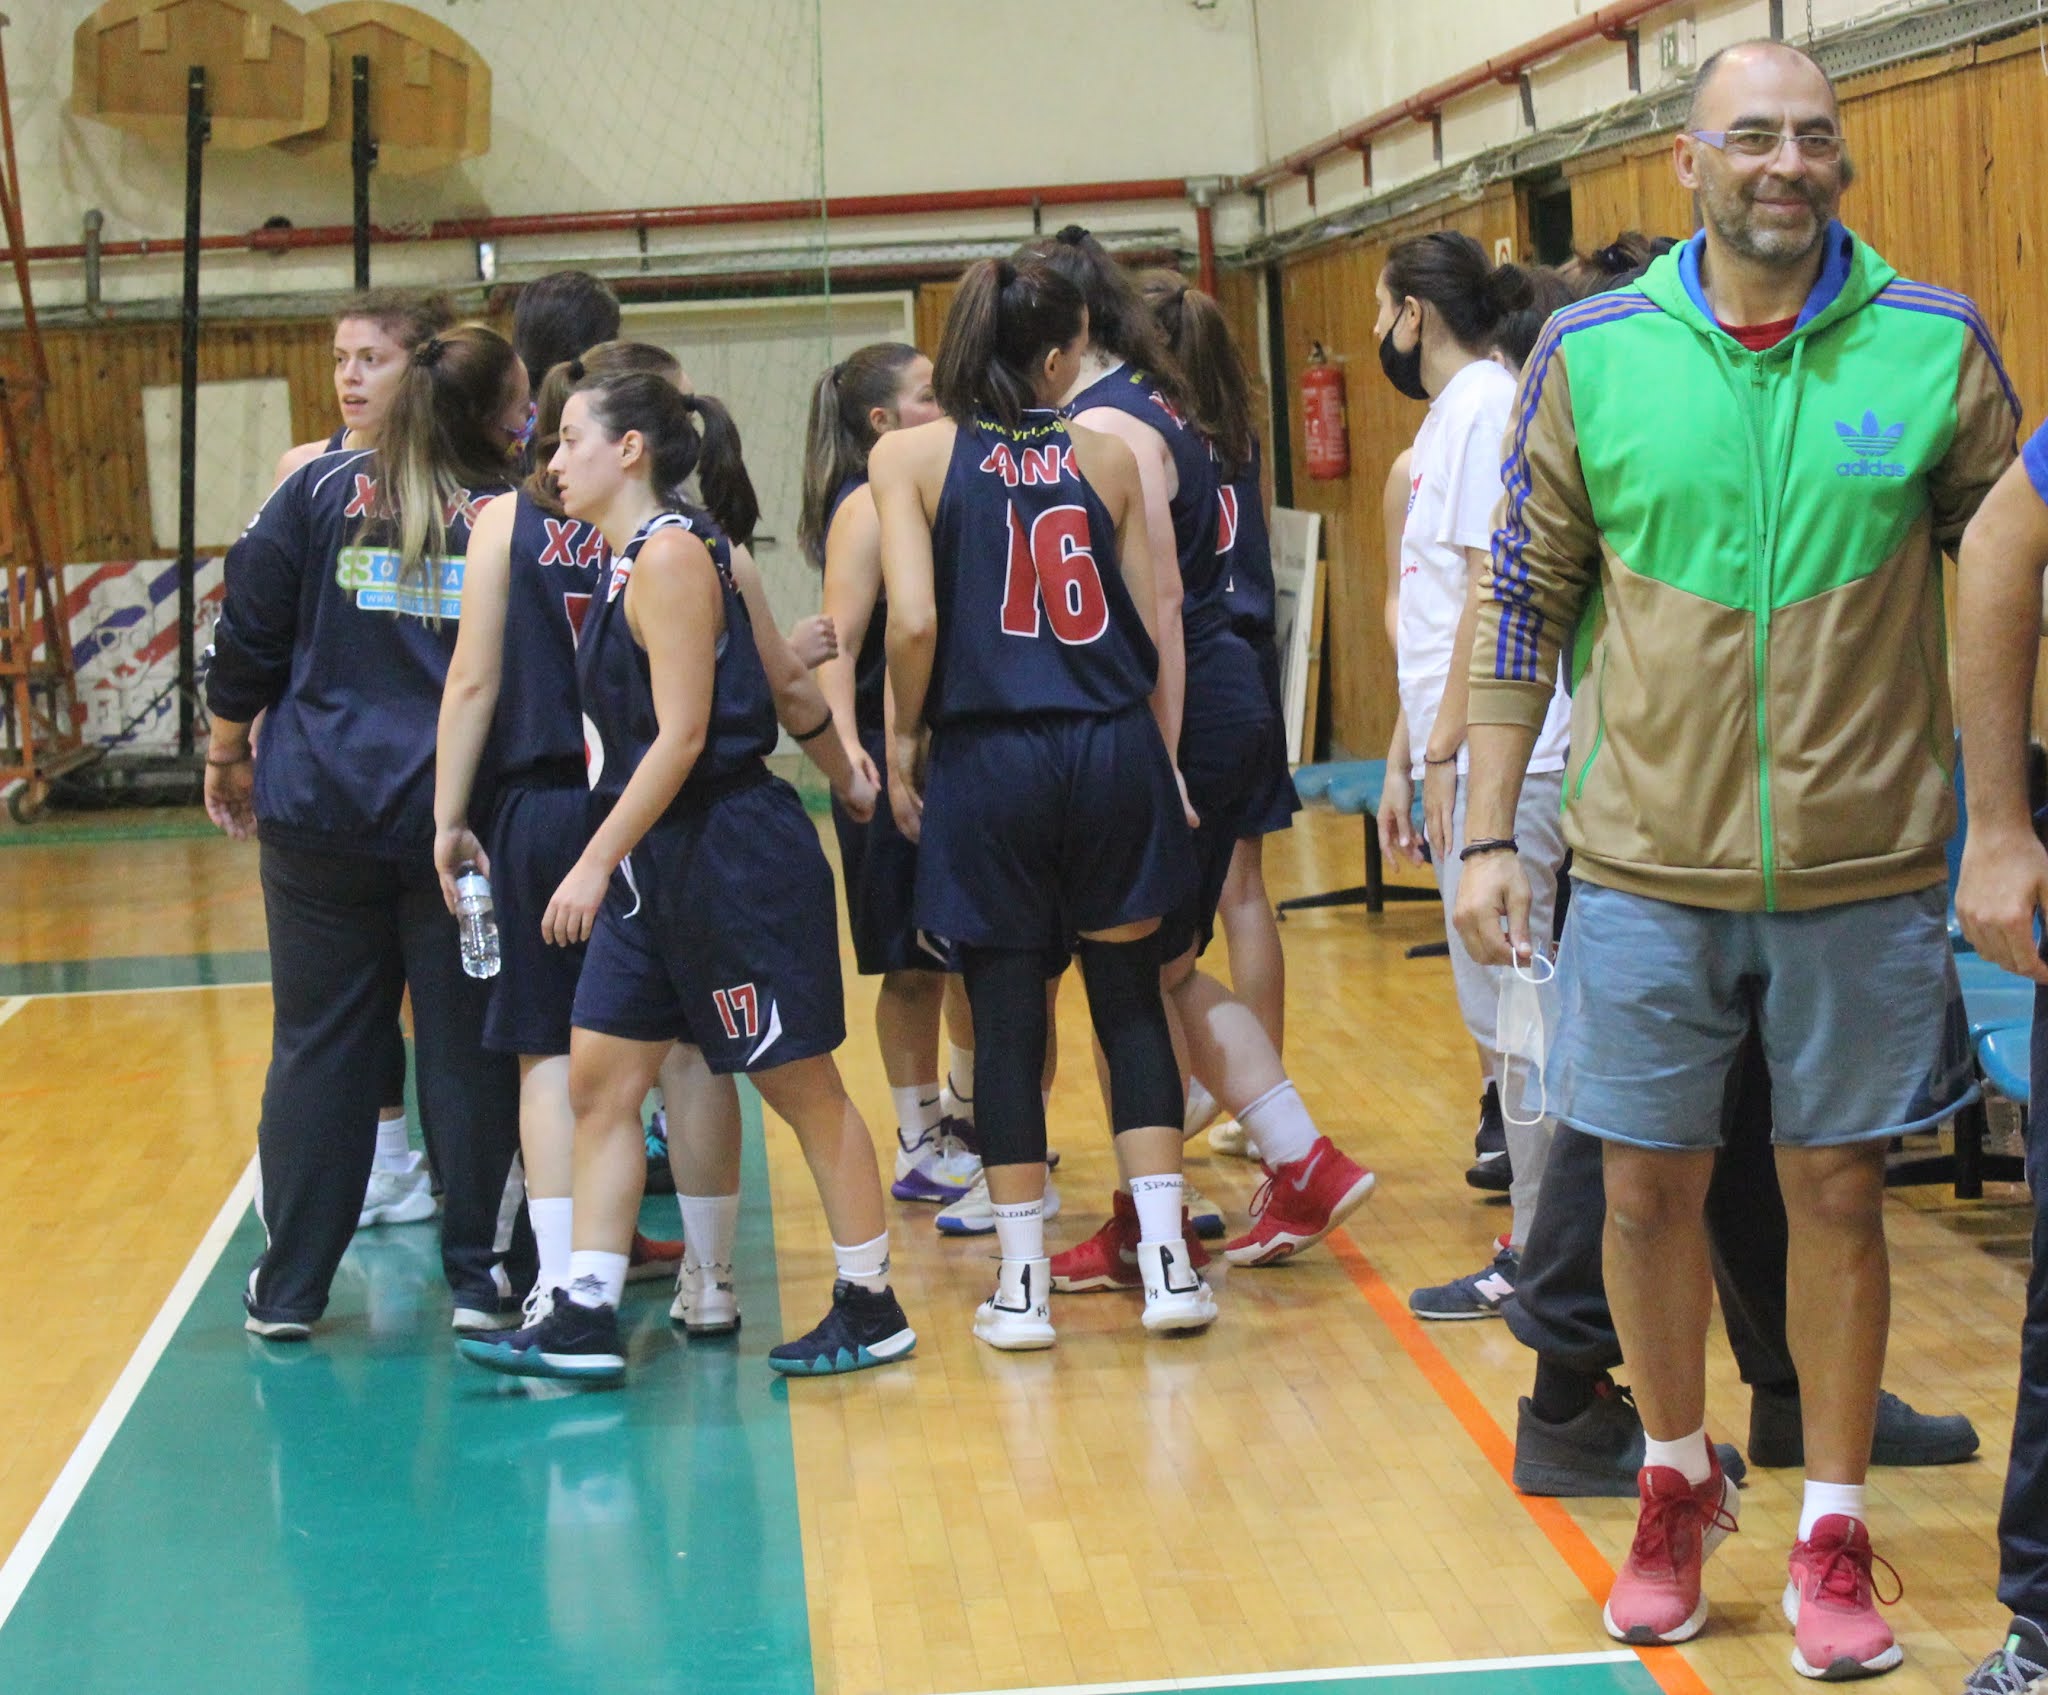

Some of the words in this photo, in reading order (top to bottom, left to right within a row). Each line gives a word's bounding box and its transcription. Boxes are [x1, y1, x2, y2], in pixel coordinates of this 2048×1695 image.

[1836, 458, 1906, 478] adidas
[1000, 498, 1109, 645] 16
[712, 982, 759, 1039] 17
